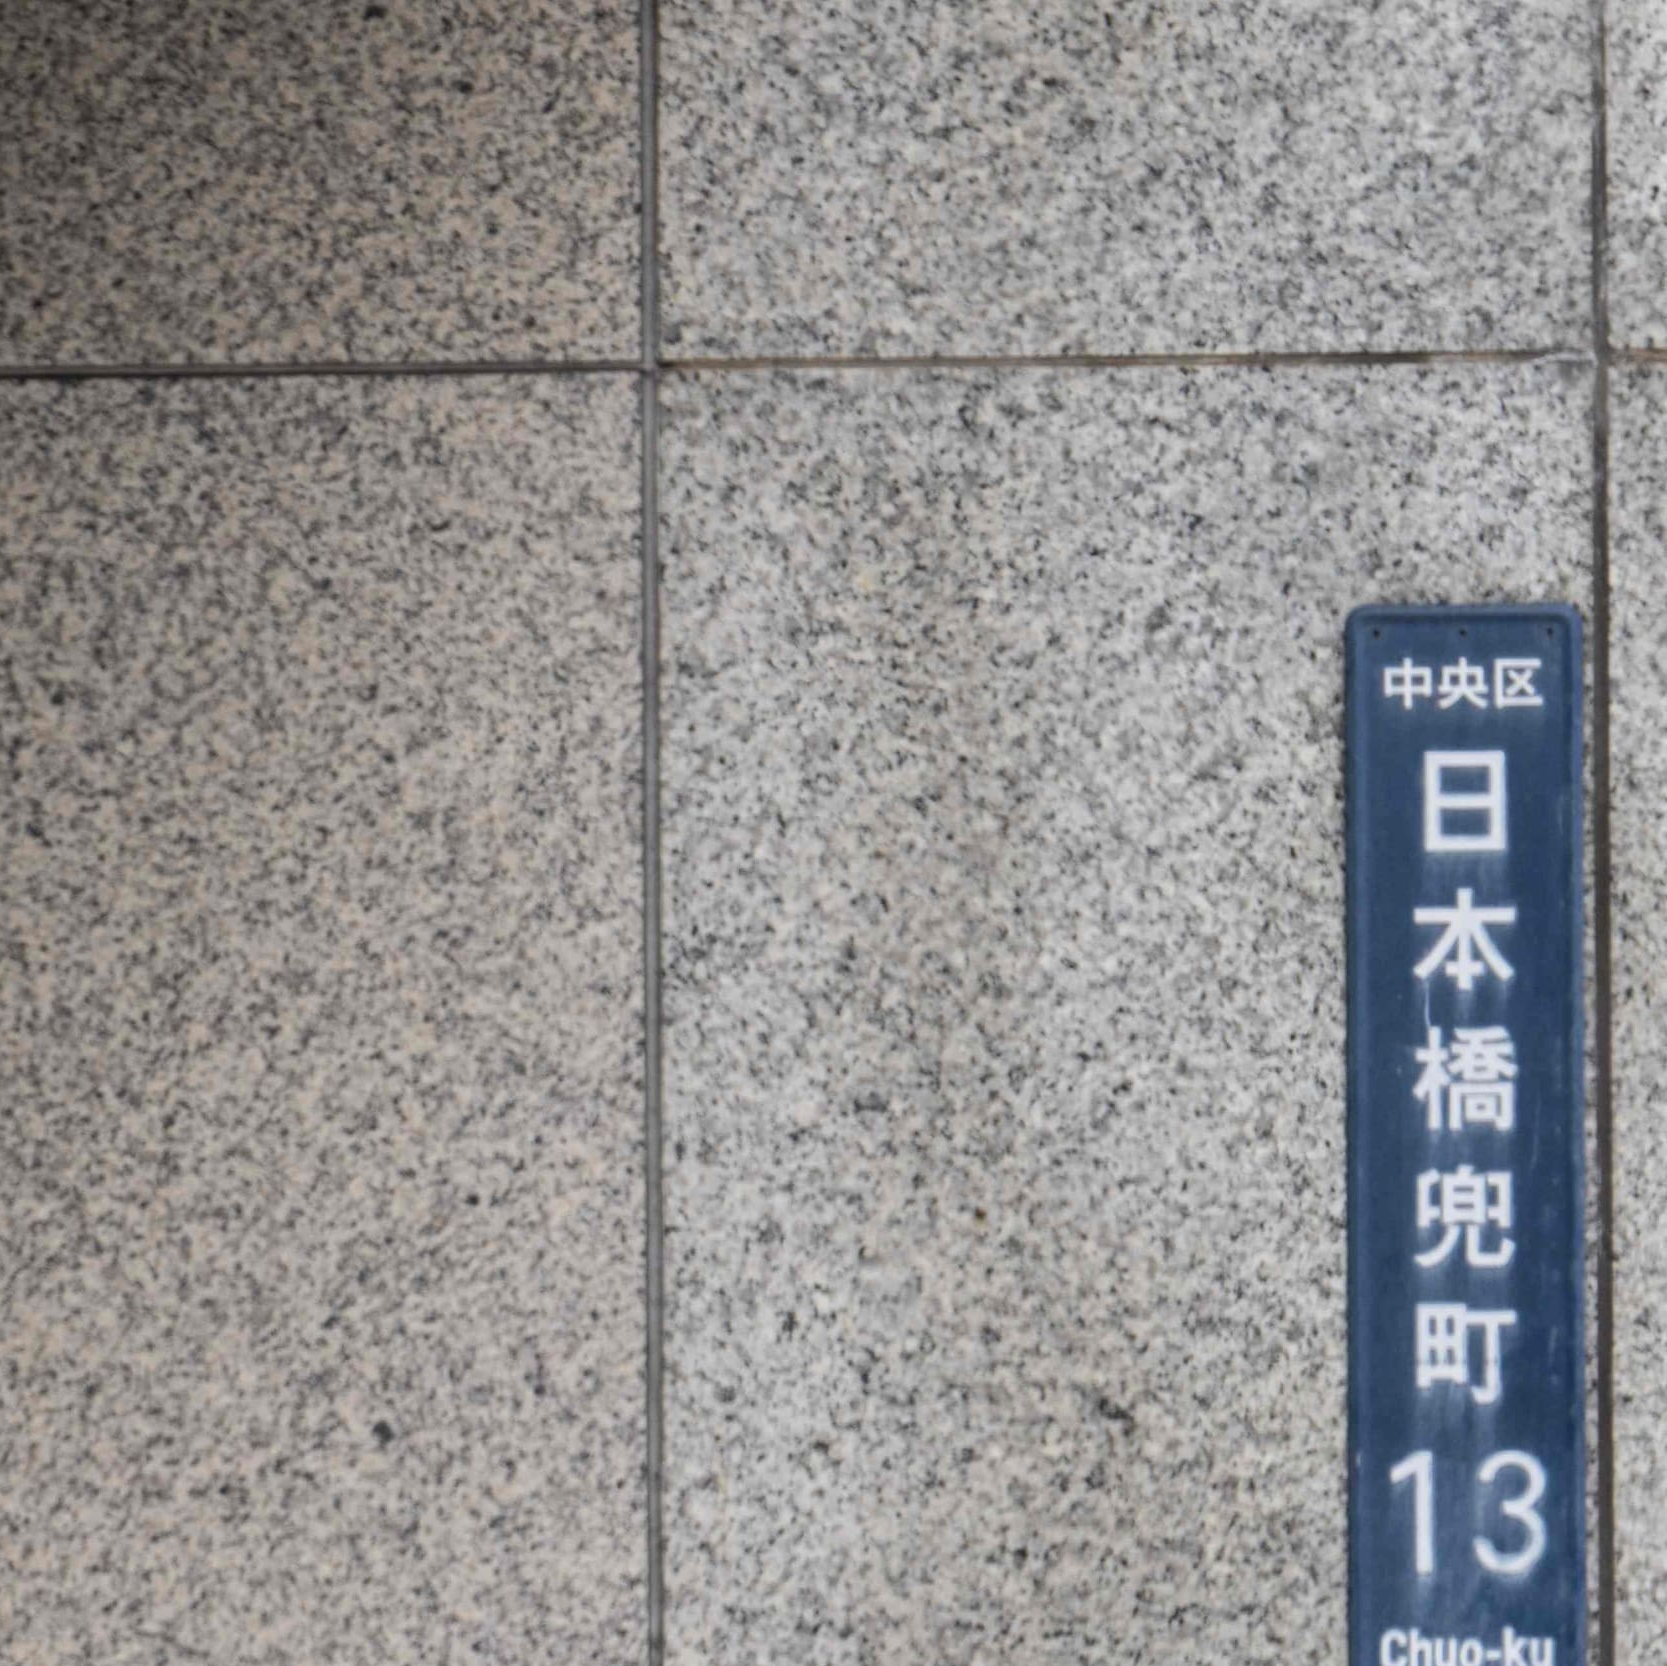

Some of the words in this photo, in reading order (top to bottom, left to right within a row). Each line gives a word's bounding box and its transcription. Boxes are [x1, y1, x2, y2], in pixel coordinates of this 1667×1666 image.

[1383, 658, 1544, 710] 中央区
[1413, 750, 1517, 1406] 日本橋兜町
[1389, 1449, 1548, 1576] 13
